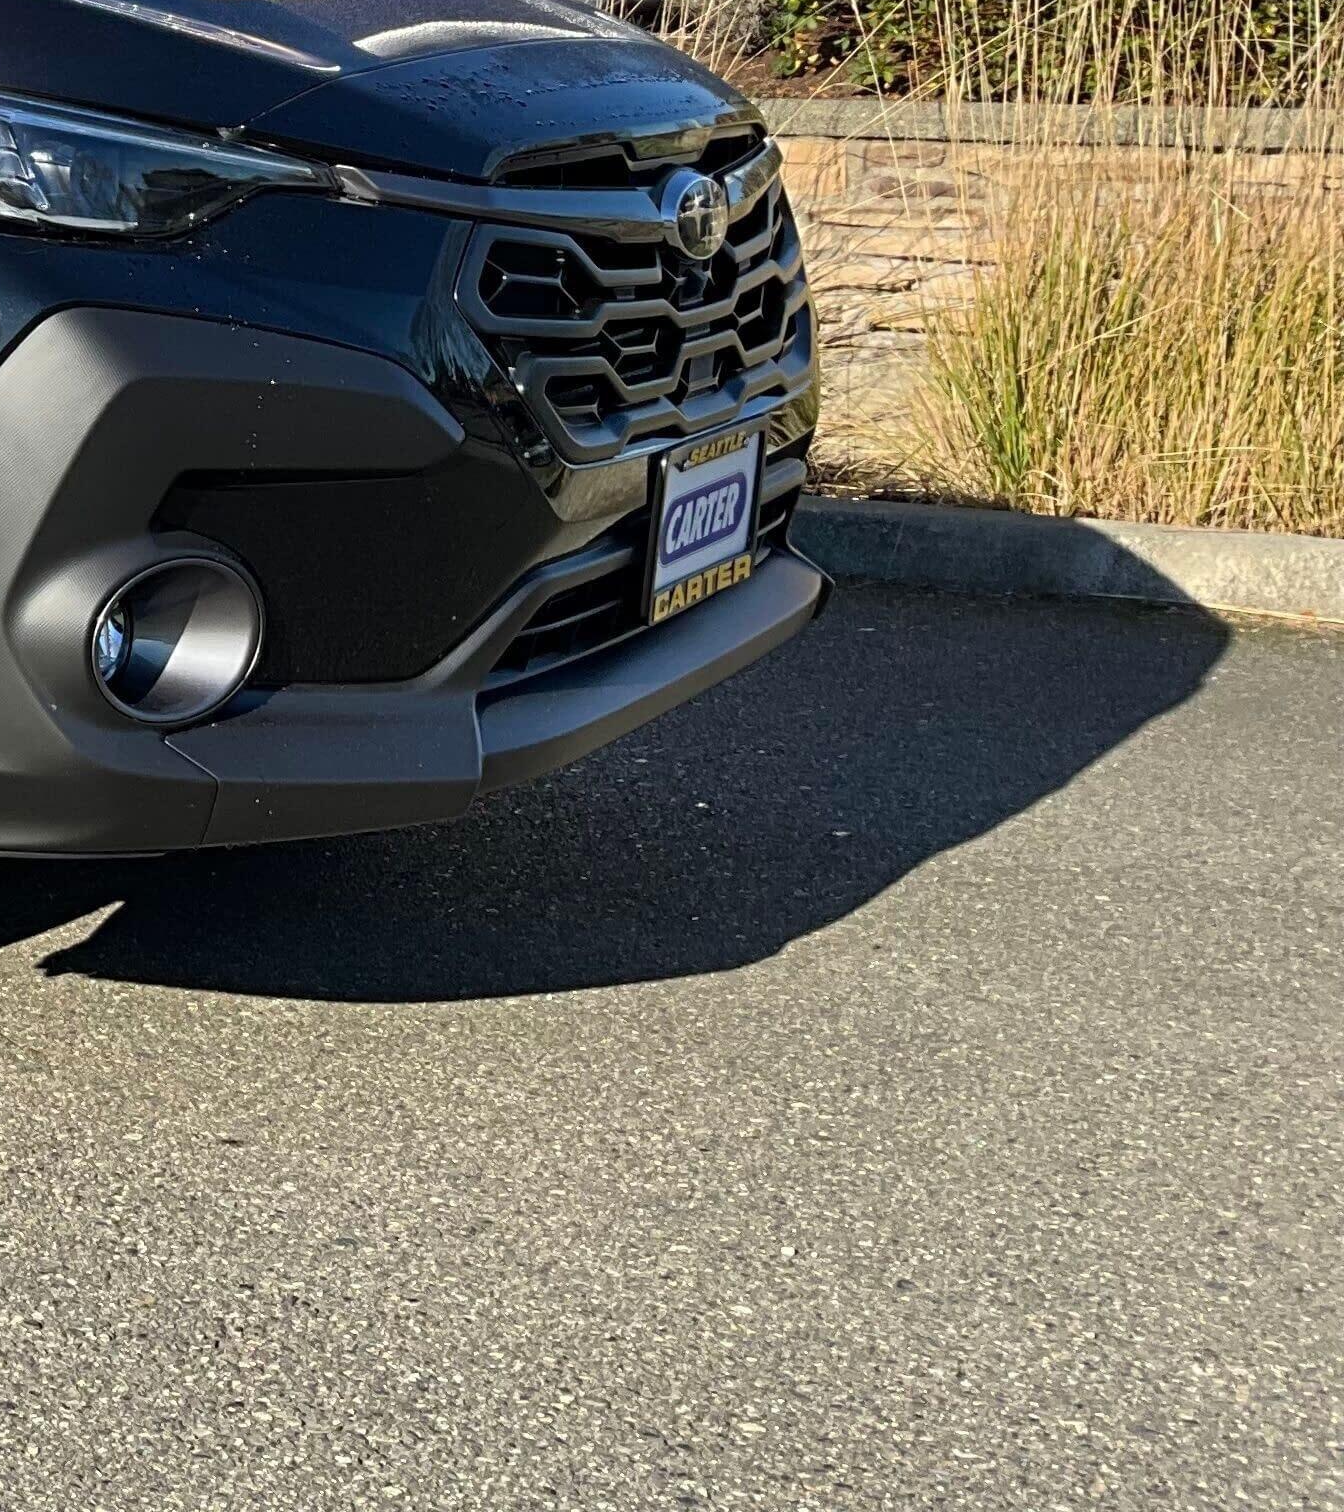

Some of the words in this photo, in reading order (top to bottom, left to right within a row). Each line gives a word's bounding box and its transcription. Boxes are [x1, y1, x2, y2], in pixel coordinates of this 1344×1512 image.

[690, 433, 746, 466] SEATTLE
[666, 482, 740, 554] CARTER
[653, 554, 752, 621] CARTER
